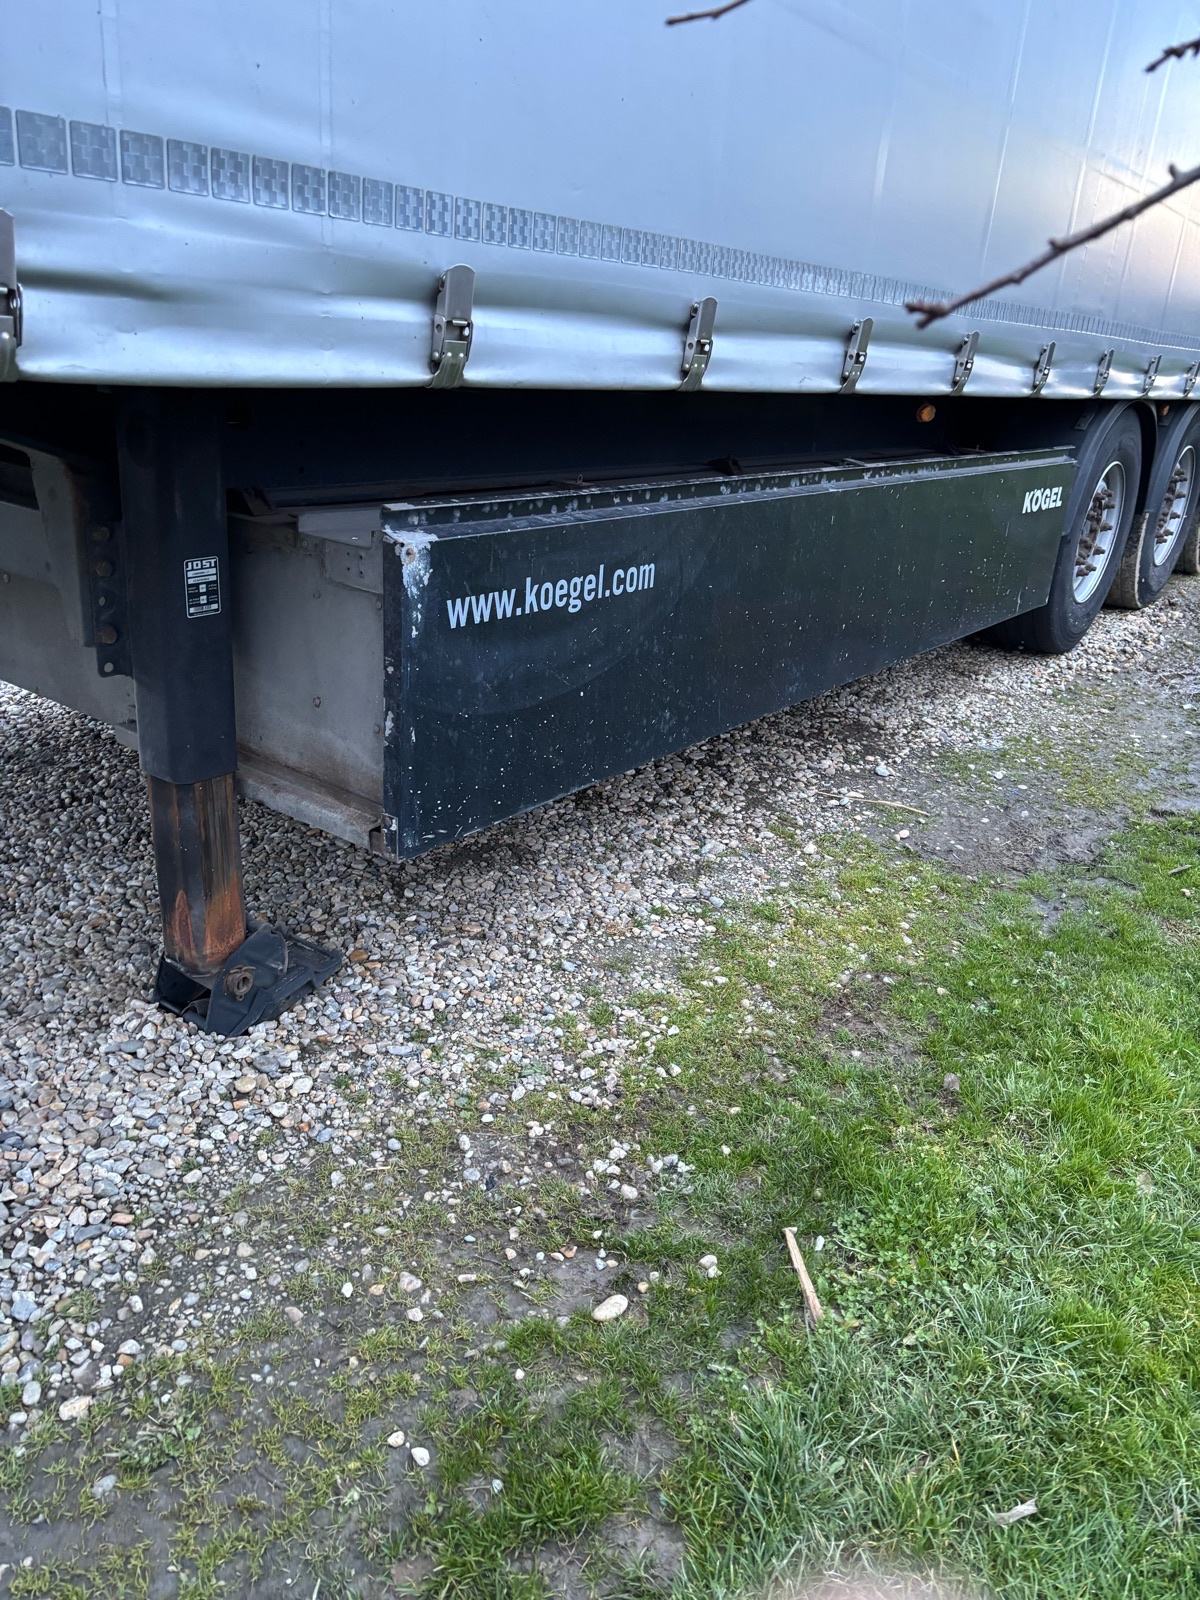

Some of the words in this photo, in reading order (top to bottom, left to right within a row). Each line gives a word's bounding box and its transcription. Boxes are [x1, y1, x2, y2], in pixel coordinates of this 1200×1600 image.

[1022, 486, 1063, 514] KÖGEL
[186, 559, 217, 570] JOST
[446, 562, 656, 629] www.koegel.com
